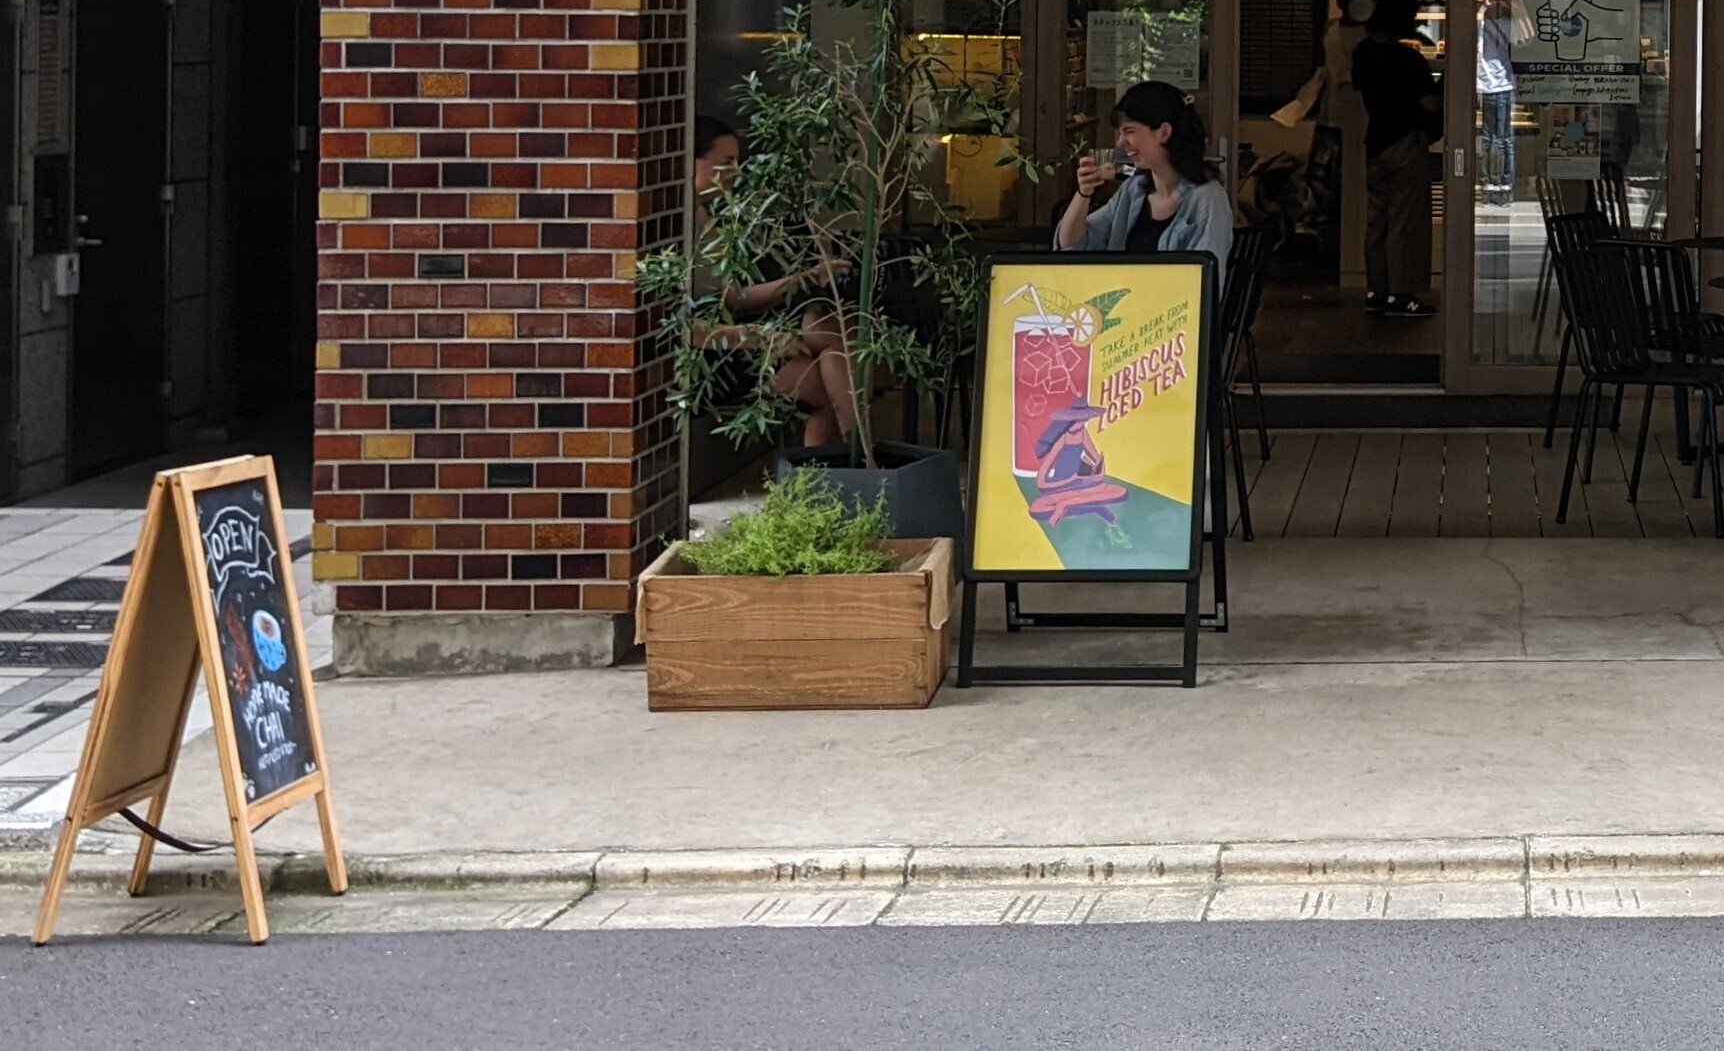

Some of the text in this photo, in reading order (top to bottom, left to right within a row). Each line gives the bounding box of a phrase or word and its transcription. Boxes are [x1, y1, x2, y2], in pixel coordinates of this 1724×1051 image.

[1529, 64, 1625, 73] SPECIAL OFFER
[1100, 300, 1188, 357] TAKE A BREAK FROM
[1102, 315, 1188, 372] SUMMER HEAT WITH
[1097, 359, 1187, 434] ICED TEA
[1100, 332, 1186, 406] HIBISCUS
[211, 518, 254, 561] OPEN
[255, 711, 285, 748] CHAI
